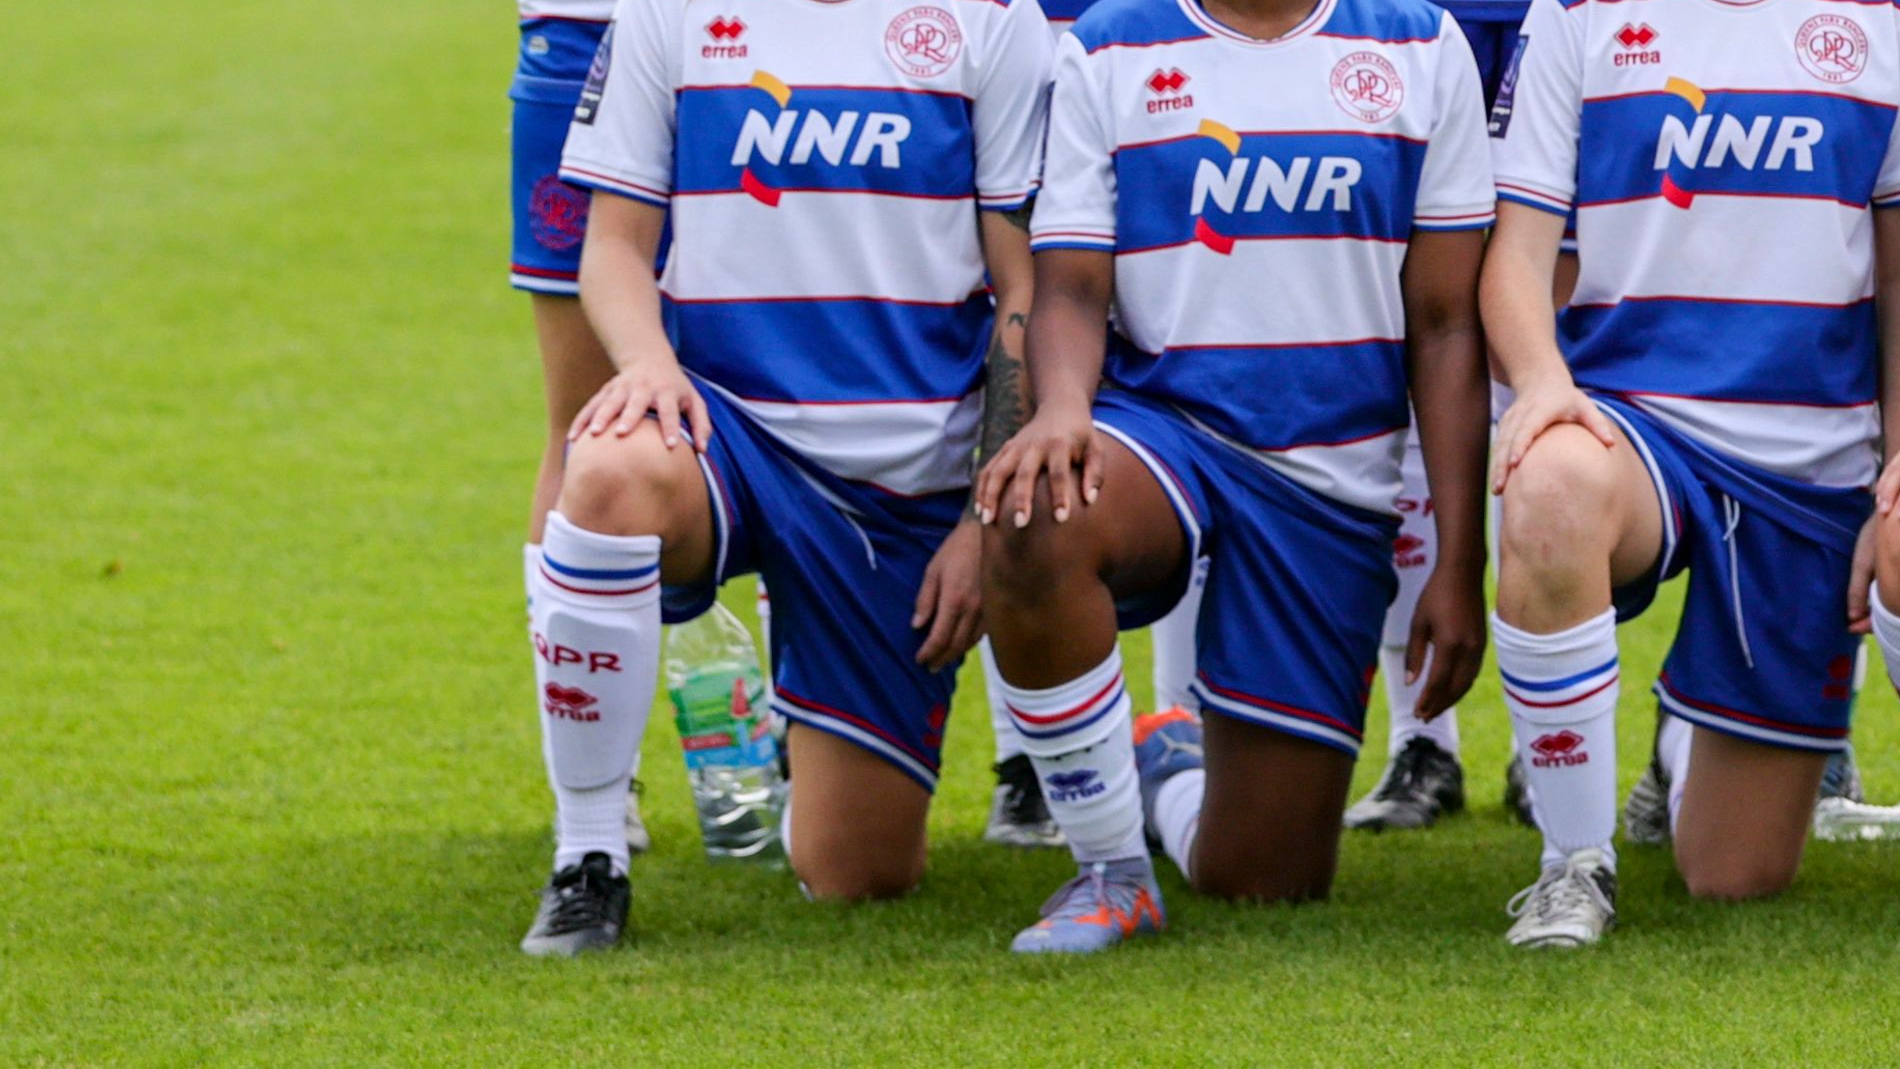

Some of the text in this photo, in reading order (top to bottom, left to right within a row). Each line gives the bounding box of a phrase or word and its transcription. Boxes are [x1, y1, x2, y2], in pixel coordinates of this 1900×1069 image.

[702, 43, 748, 59] errea
[1614, 49, 1660, 66] errea
[1147, 94, 1193, 114] errea
[731, 108, 911, 168] NNR
[1653, 113, 1824, 172] NNR
[1190, 156, 1362, 216] NNR
